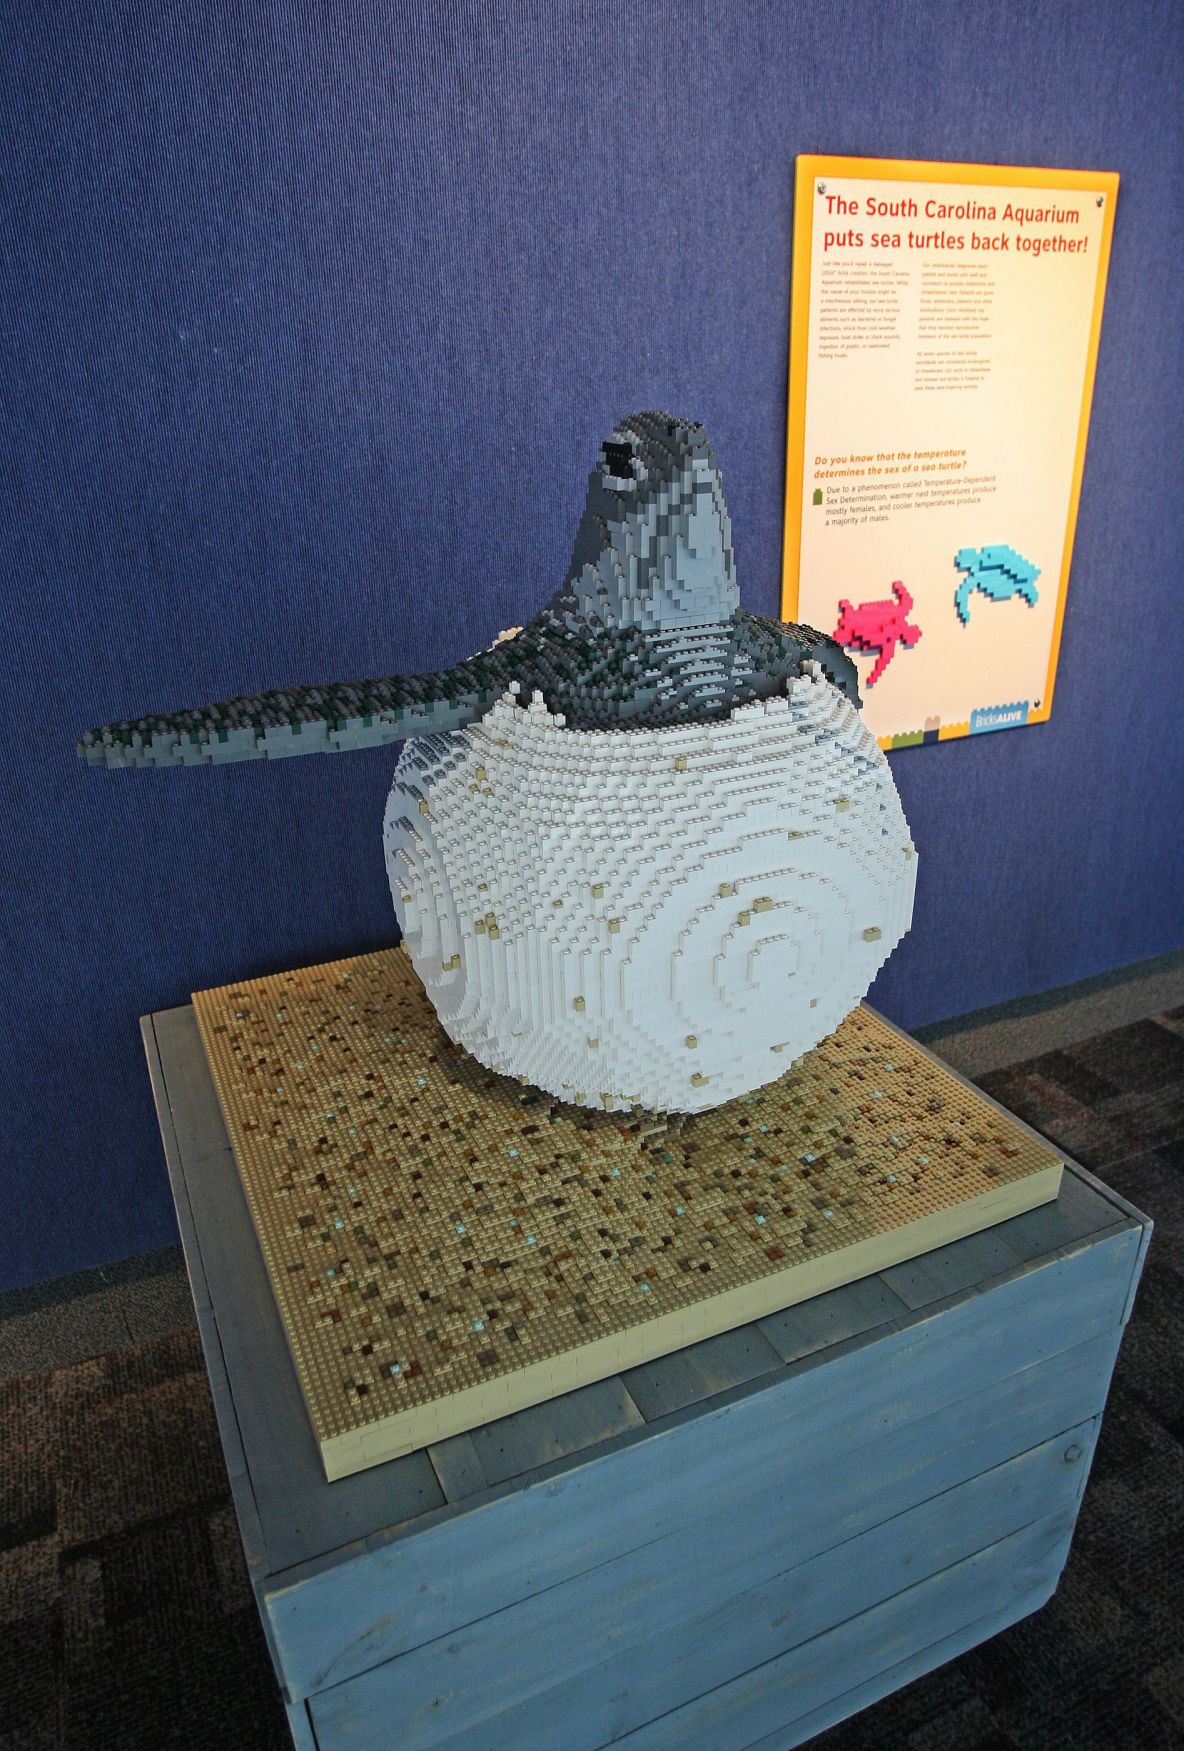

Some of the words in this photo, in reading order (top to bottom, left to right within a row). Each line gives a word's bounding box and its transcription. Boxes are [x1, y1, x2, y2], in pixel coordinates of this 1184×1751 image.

[825, 196, 859, 215] The
[866, 197, 918, 217] South
[925, 200, 996, 220] Carolina
[1003, 203, 1079, 226] Aquarium
[824, 230, 863, 251] puts
[870, 232, 900, 247] sea
[908, 232, 964, 249] turtles
[971, 232, 1009, 251] back
[1016, 236, 1088, 257] together!
[815, 457, 827, 465] Do
[831, 456, 847, 466] you
[850, 454, 873, 463] know
[877, 453, 895, 461] that
[914, 449, 966, 461] temperature
[814, 469, 864, 479] determines
[885, 466, 899, 474] sex
[903, 464, 912, 472] of
[939, 461, 967, 470] turtle?
[840, 494, 887, 504] Determination,
[890, 492, 913, 500] warmer
[931, 487, 970, 497] temperatures
[972, 485, 996, 494] produce
[858, 482, 900, 492] phenomenon
[903, 480, 922, 488] called
[826, 507, 847, 516] mostly
[850, 504, 876, 513] females,
[893, 501, 913, 509] cooler
[915, 498, 955, 508] temperatures
[957, 497, 981, 506] produce
[832, 516, 858, 526] majority
[861, 515, 867, 523] of
[870, 514, 889, 522] males.
